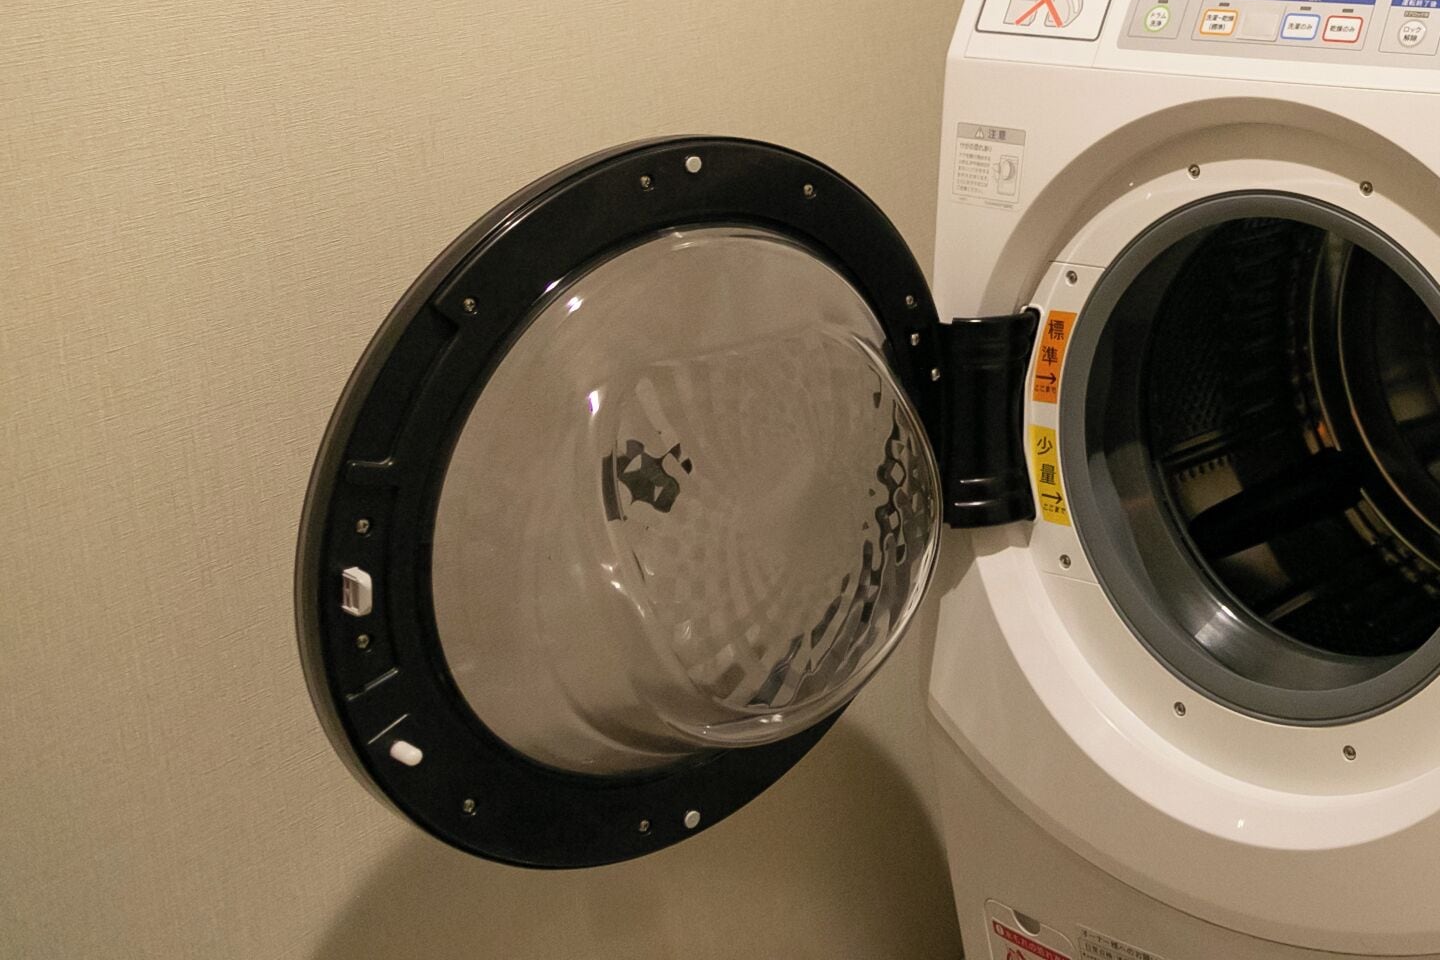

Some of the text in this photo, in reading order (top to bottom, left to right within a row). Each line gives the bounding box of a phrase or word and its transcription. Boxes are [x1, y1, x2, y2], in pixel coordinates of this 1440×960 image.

[1150, 11, 1167, 20] ドラム
[1288, 22, 1314, 32] 洗濯のみ
[1329, 24, 1356, 34] 乾燥のみ
[1403, 26, 1422, 34] ロック
[988, 128, 1007, 141] 注意
[1042, 319, 1065, 366] 標準
[1037, 436, 1056, 486] 少量
